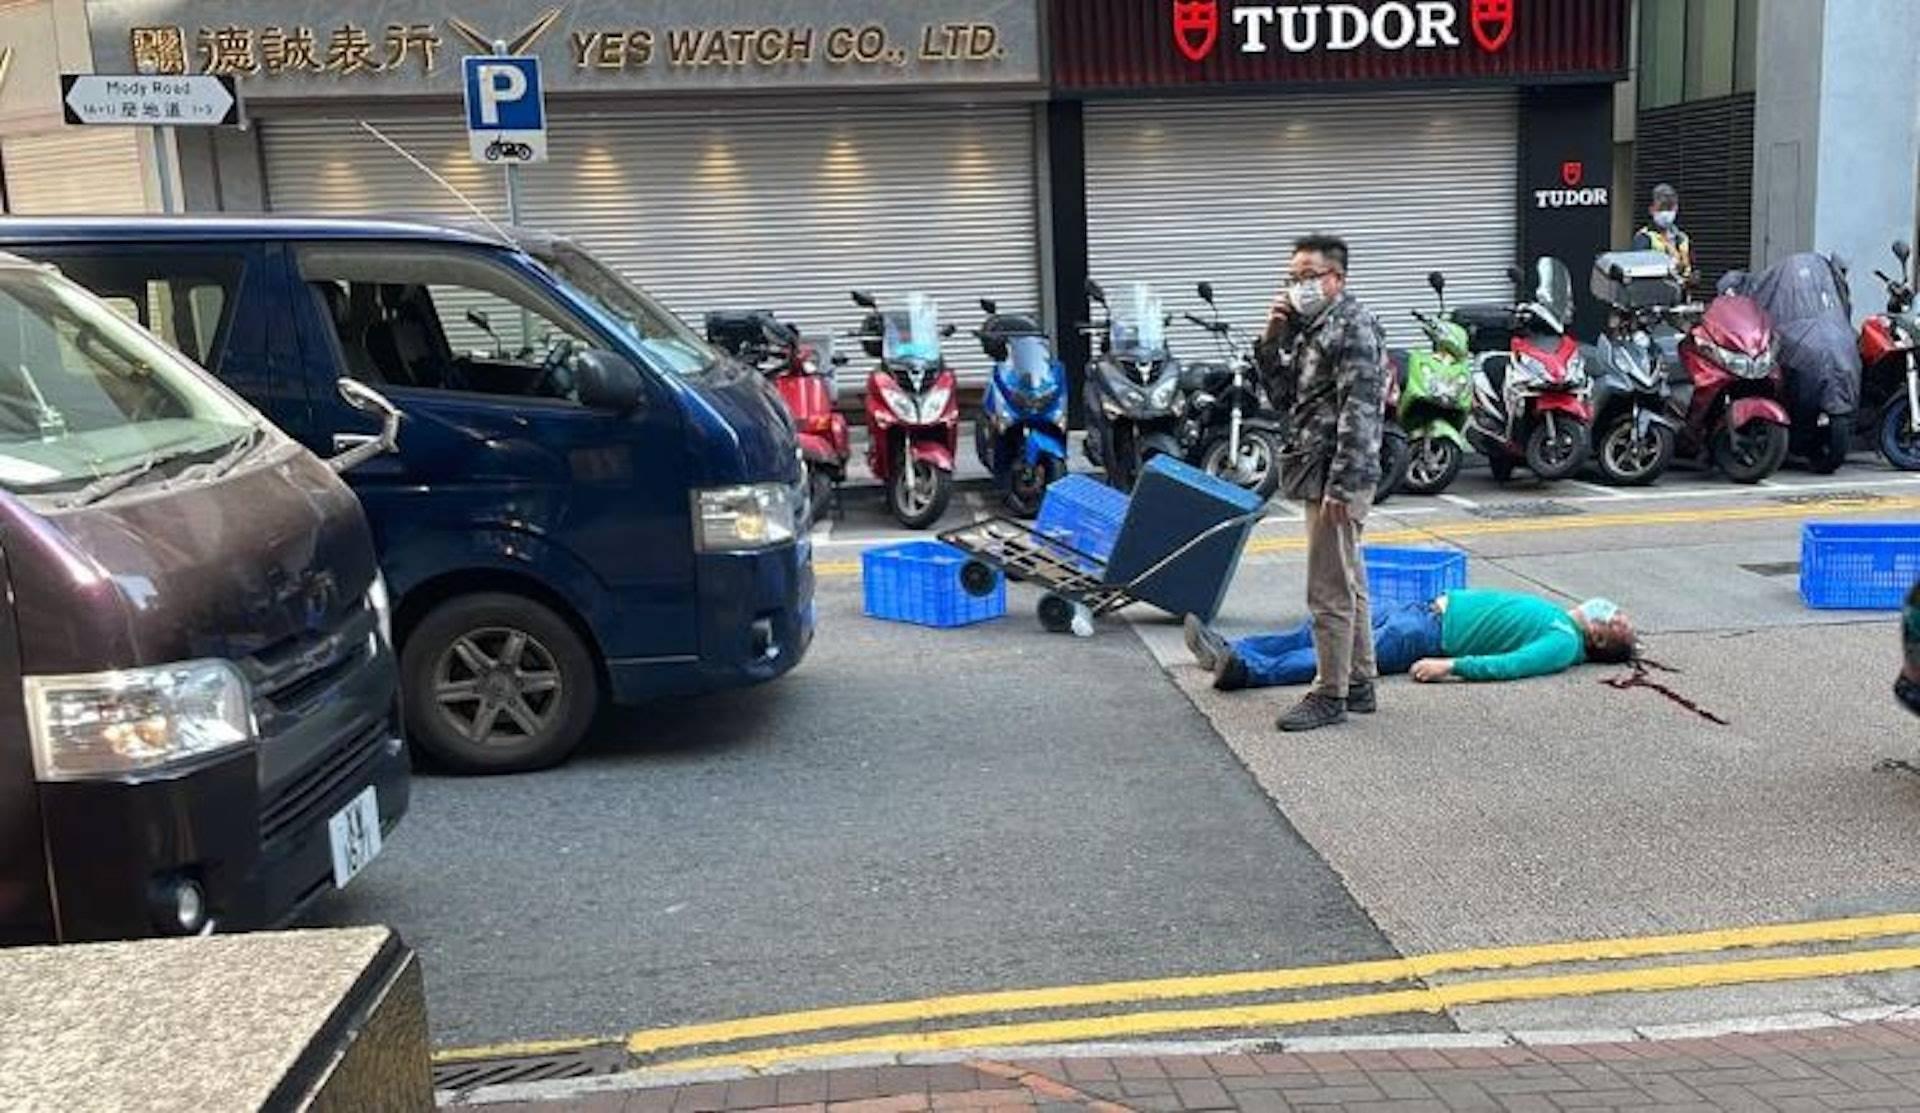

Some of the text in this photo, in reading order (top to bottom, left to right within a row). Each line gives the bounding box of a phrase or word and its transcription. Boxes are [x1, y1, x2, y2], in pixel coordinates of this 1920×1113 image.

[198, 24, 441, 75] 德誠表行
[572, 23, 1005, 67] YES WATCH CO., LTD.
[1232, 1, 1459, 52] TUDOR
[106, 81, 190, 96] Mody Road
[477, 64, 527, 124] P
[1534, 187, 1608, 209] TUDOR
